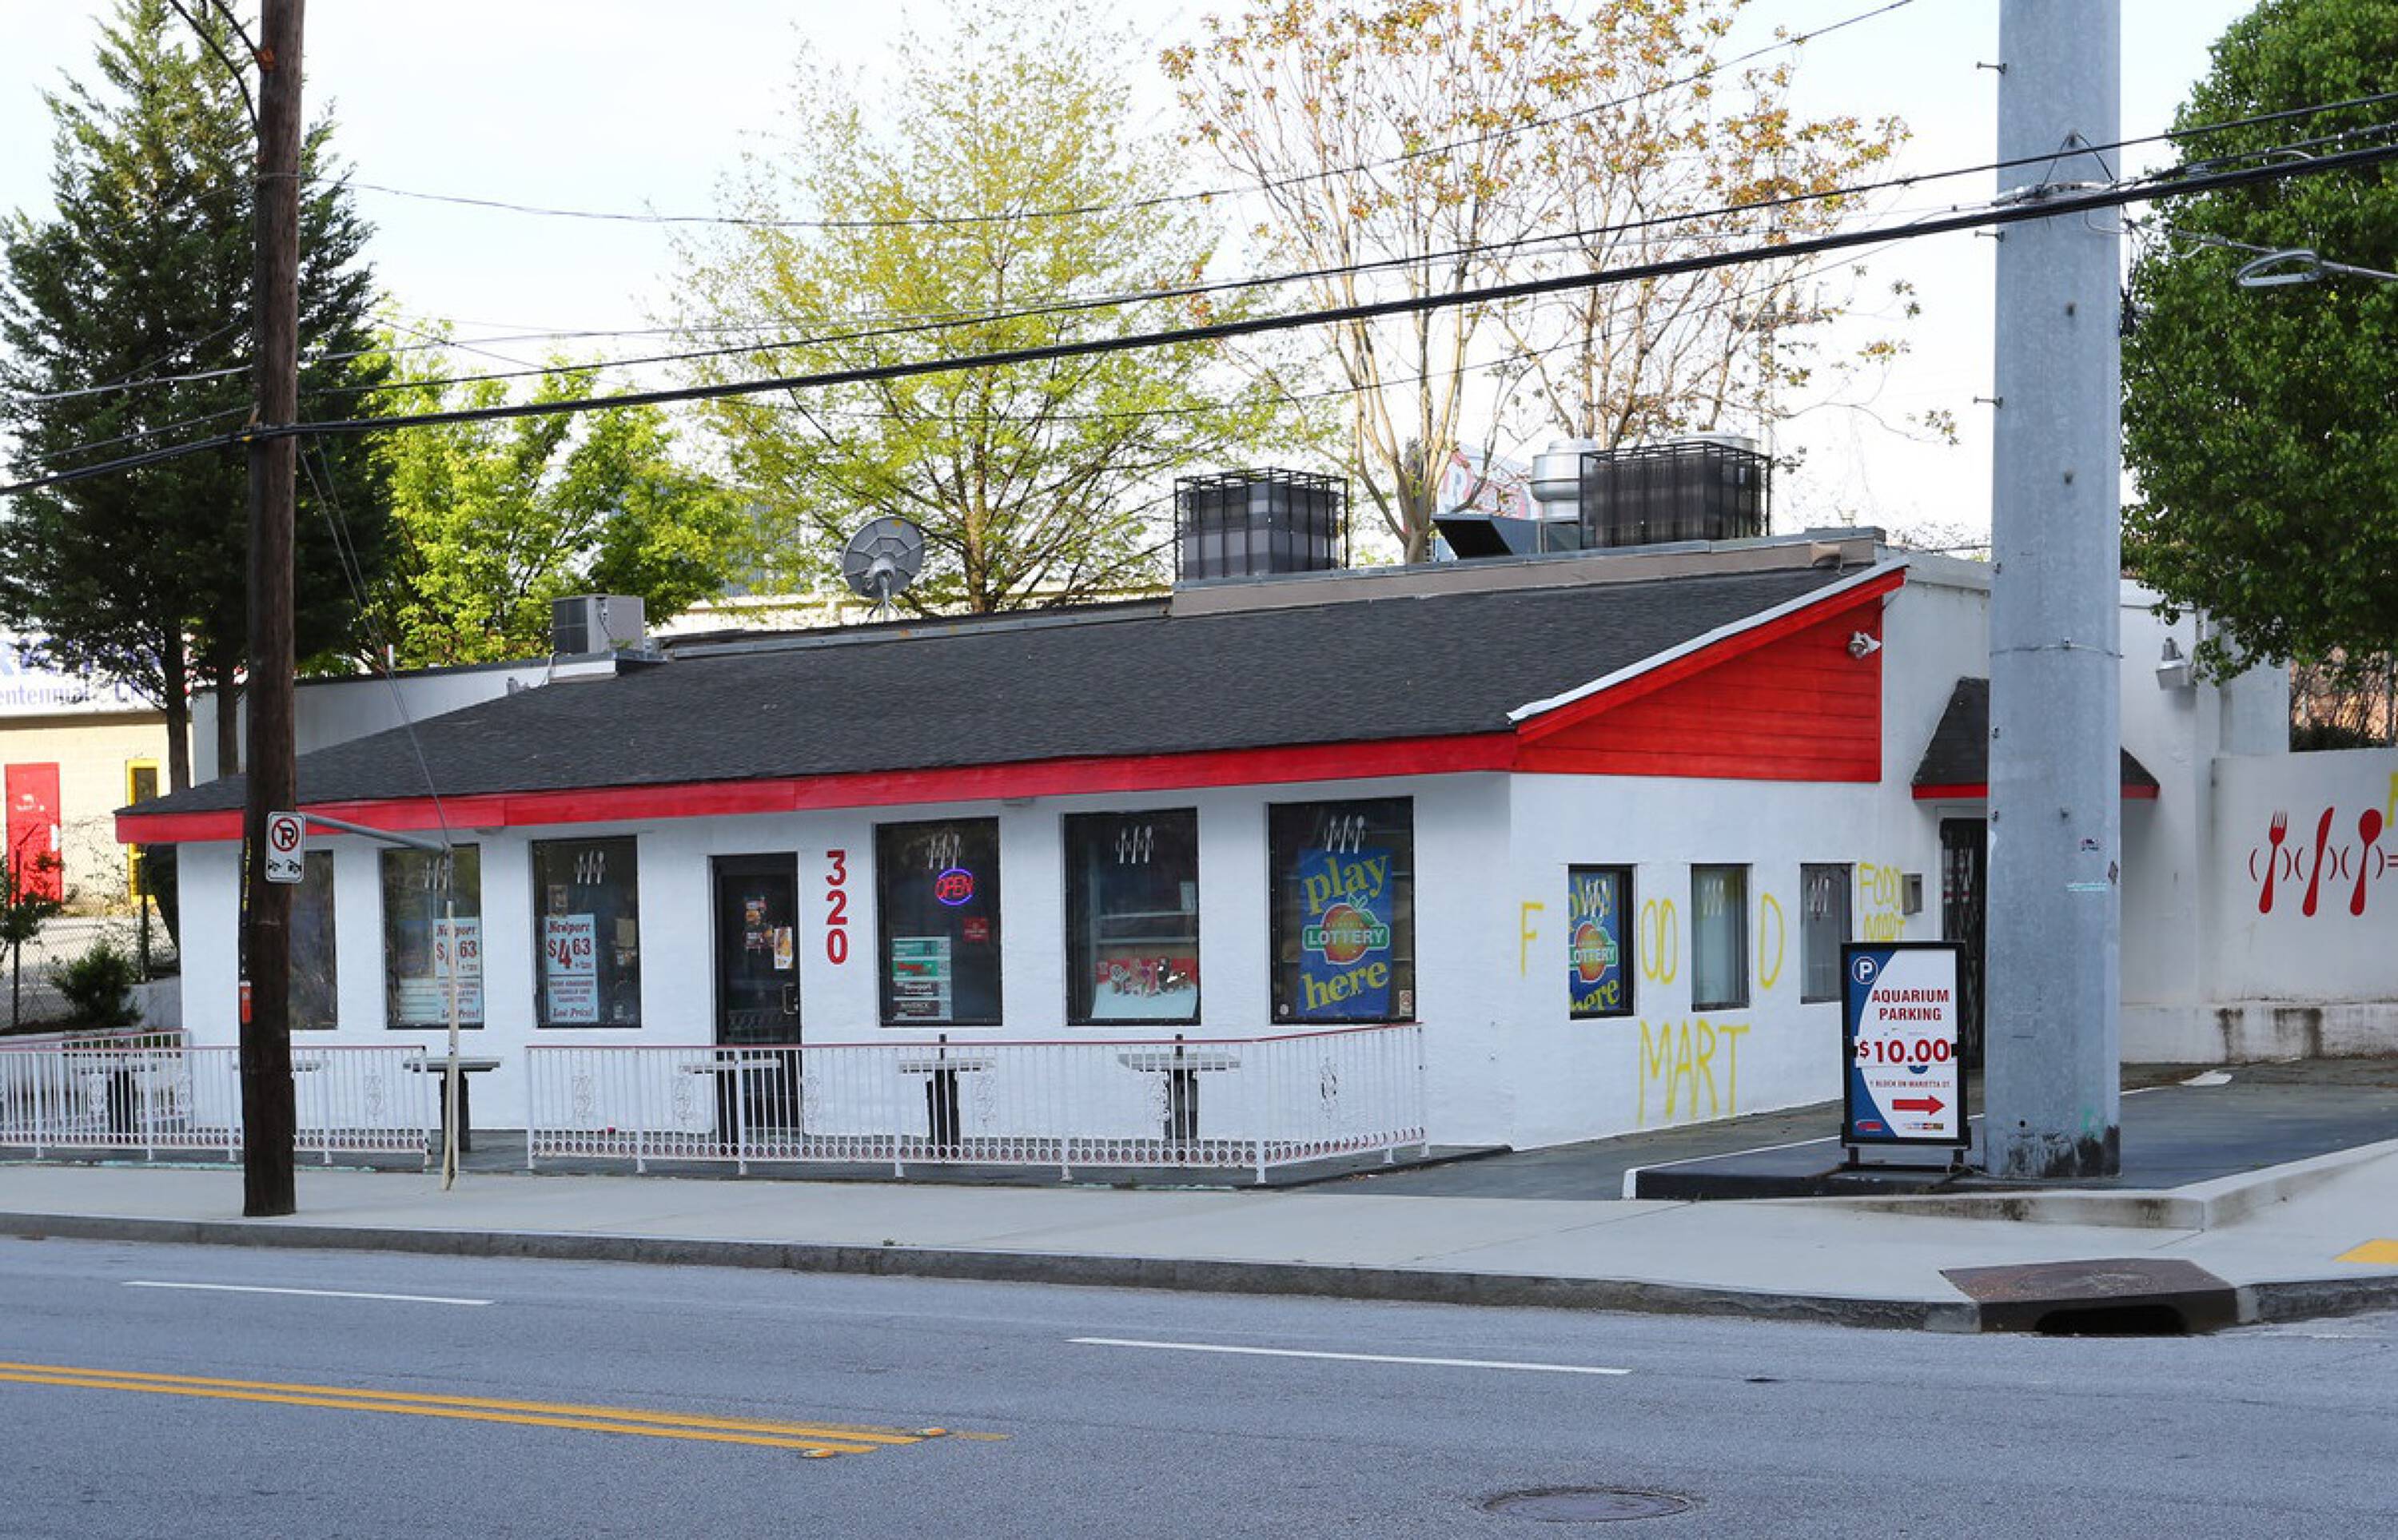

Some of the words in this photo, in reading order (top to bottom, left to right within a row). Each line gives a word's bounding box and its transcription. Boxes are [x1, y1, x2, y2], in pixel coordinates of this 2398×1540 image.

[935, 875, 974, 898] OPEN
[1305, 856, 1388, 915] play
[826, 850, 848, 965] 320
[549, 921, 590, 934] Newport
[1308, 929, 1384, 945] LOTTERY
[1303, 962, 1388, 1010] here
[1872, 989, 1950, 1003] AQUARIUM
[1880, 1008, 1942, 1021] PARKING
[1859, 1039, 1950, 1064] $10.00
[1639, 1019, 1750, 1125] MART
